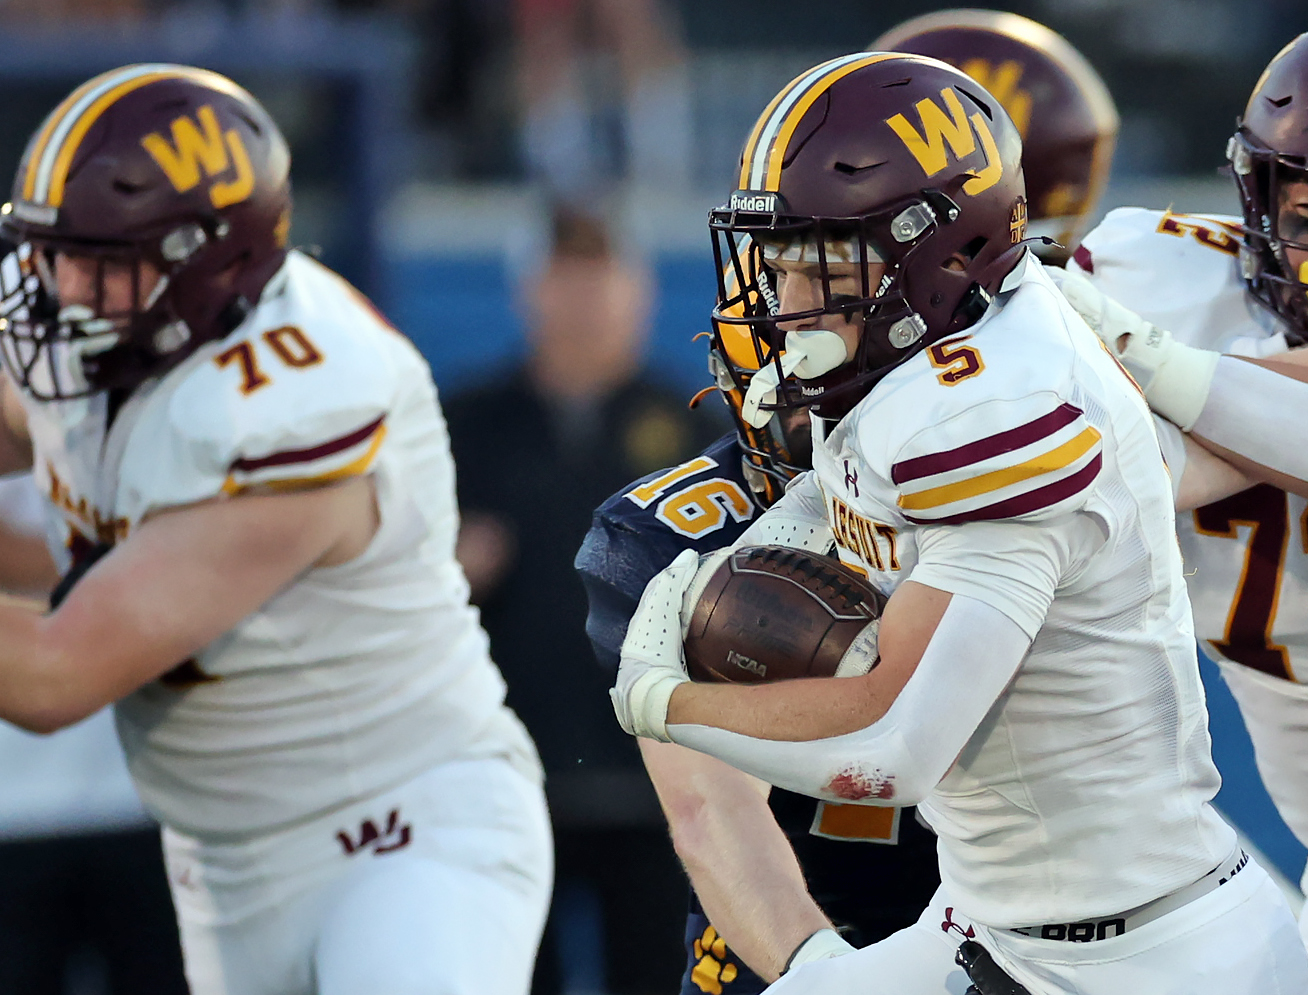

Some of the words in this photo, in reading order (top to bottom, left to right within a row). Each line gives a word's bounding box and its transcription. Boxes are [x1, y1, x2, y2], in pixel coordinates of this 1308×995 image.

[141, 106, 256, 208] WJ
[886, 86, 1003, 196] WJ
[731, 195, 775, 212] Riddell
[213, 324, 325, 397] 70
[927, 336, 986, 387] 5
[622, 455, 755, 540] 16
[726, 649, 767, 677] NCAA
